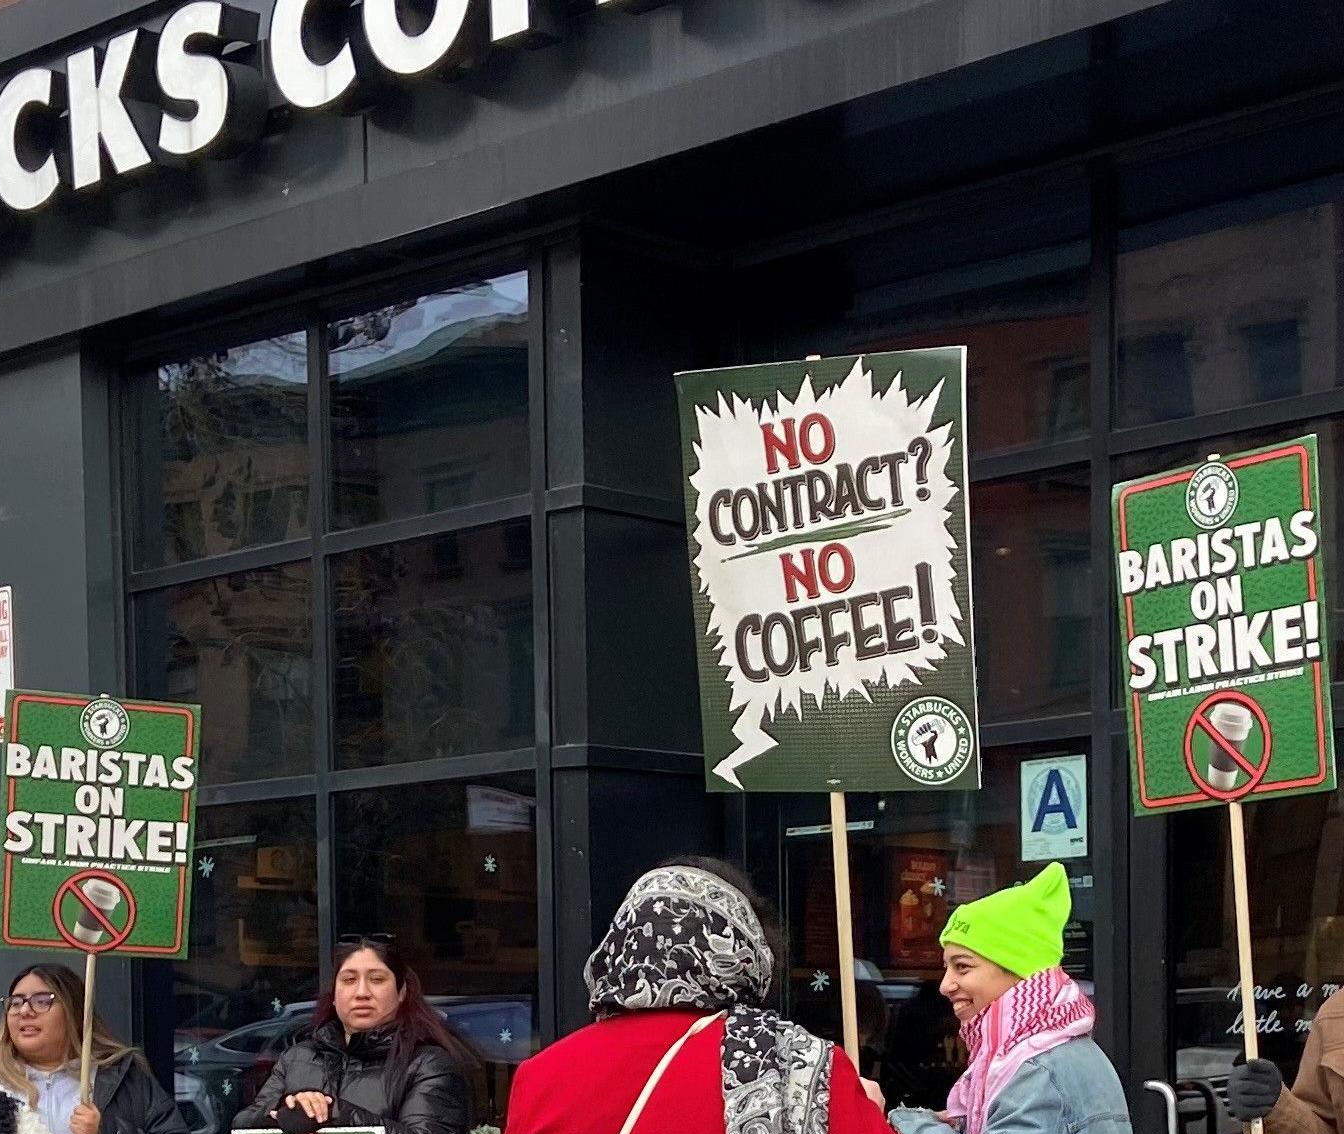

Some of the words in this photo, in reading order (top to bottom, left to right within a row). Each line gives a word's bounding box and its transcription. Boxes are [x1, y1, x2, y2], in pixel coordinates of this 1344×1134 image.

[759, 412, 836, 474] NO
[708, 436, 932, 546] CONTRACT?
[779, 543, 856, 601] NO
[1119, 510, 1317, 594] BARISTAS
[735, 561, 939, 683] COFFEE!
[1190, 575, 1243, 620] ON
[1128, 600, 1321, 689] STRIKE!
[901, 702, 961, 726] STARBUCKS
[6, 743, 195, 791] BARISTAS
[897, 740, 934, 779] WORKERS
[944, 738, 968, 774] UNITED
[74, 785, 124, 817] ON
[1031, 769, 1077, 832] A
[3, 812, 189, 864] STRIKE!
[1296, 983, 1313, 998] a
